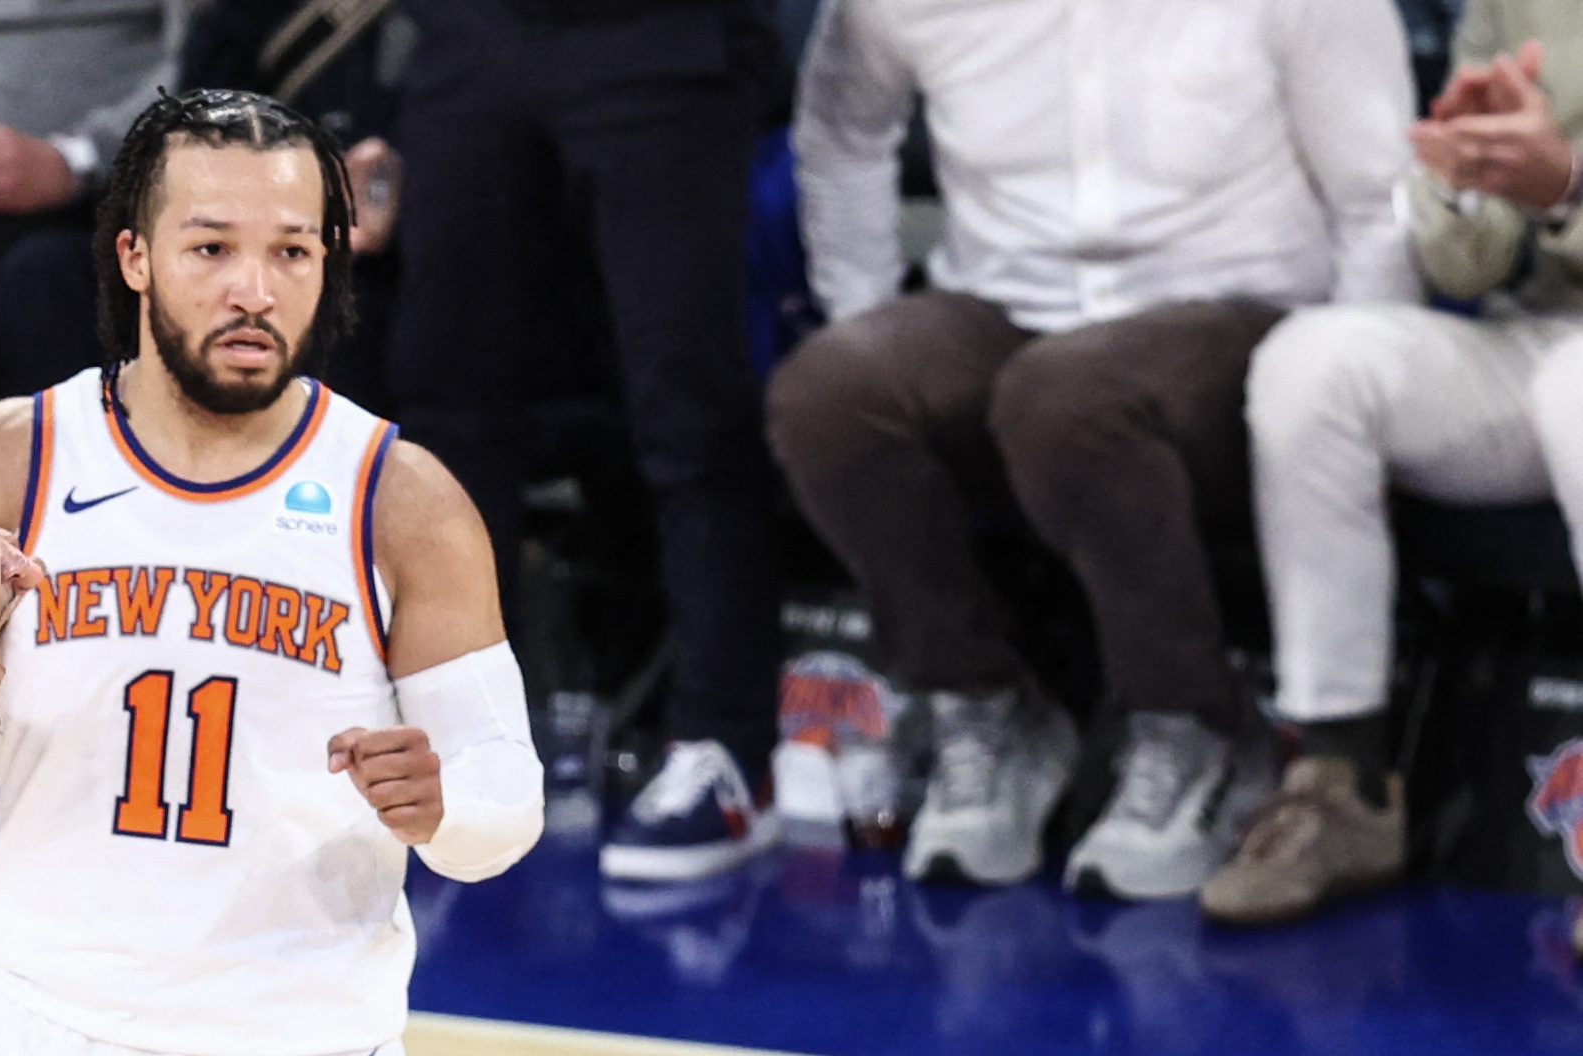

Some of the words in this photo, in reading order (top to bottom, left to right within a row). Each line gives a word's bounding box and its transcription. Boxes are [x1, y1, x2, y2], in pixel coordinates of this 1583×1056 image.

[275, 514, 338, 537] sphere
[35, 566, 175, 647] NEW
[184, 566, 349, 676] YORK
[112, 668, 238, 847] 11
